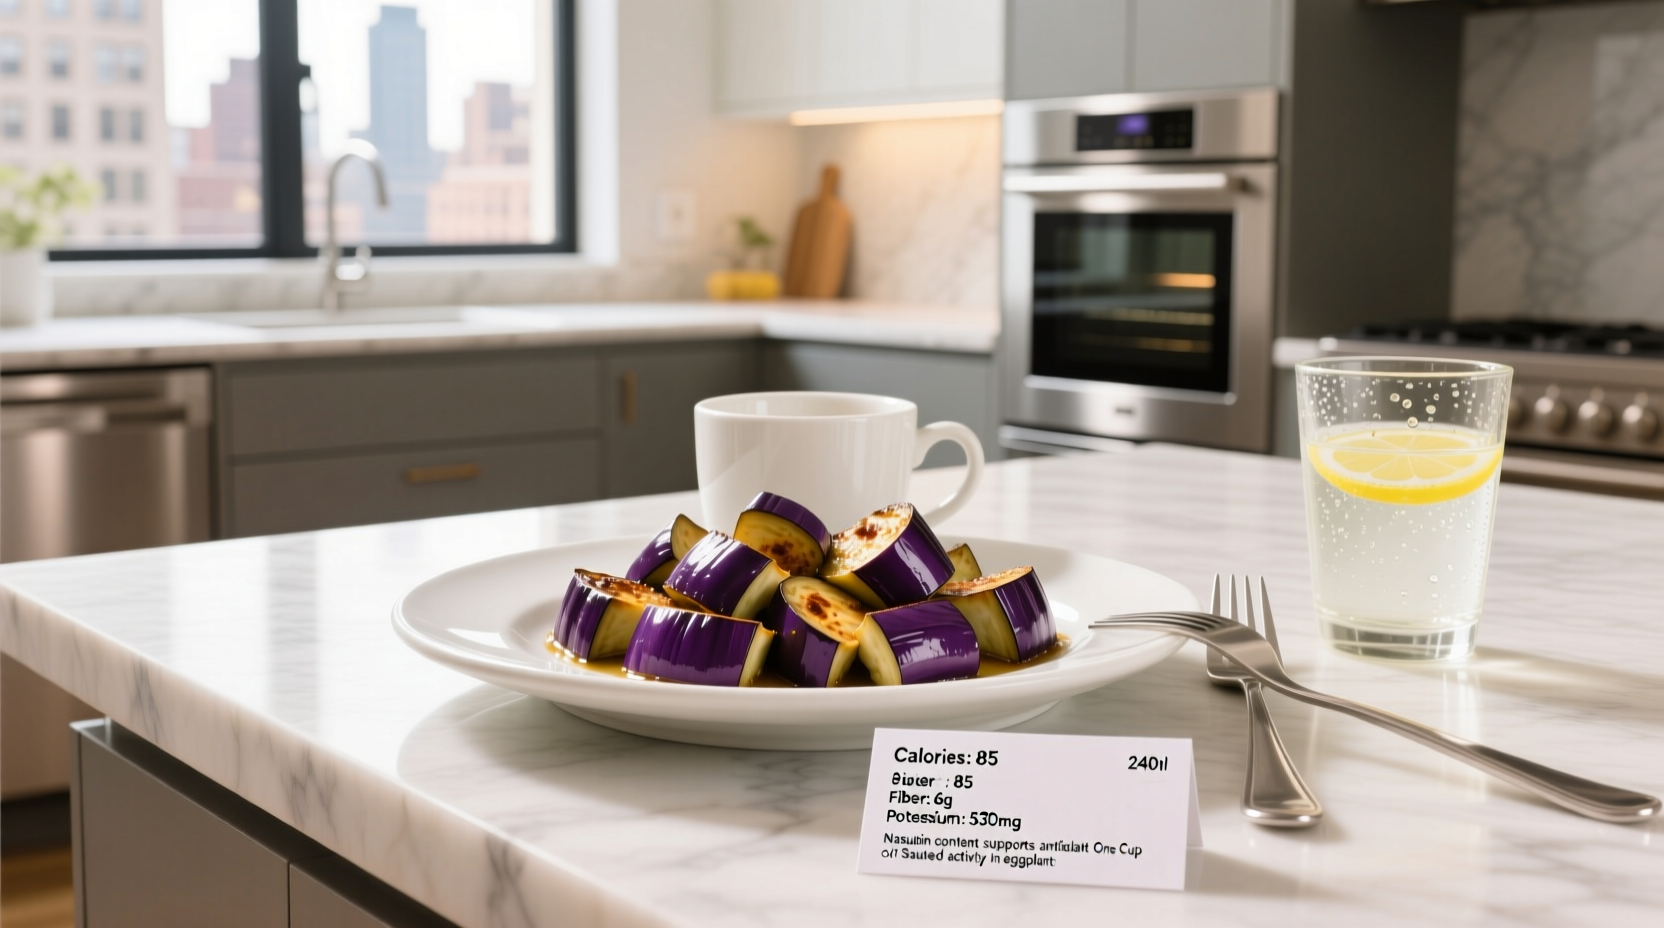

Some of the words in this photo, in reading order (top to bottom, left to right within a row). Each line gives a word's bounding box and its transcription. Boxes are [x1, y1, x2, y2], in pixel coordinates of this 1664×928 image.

[893, 746, 972, 765] Calories:
[975, 749, 999, 767] 85
[953, 774, 974, 790] 85
[933, 791, 953, 810] 6g
[968, 810, 1022, 833] 530mg
[982, 839, 1036, 854] supports
[1093, 841, 1117, 855] One
[1118, 842, 1143, 860] Cup
